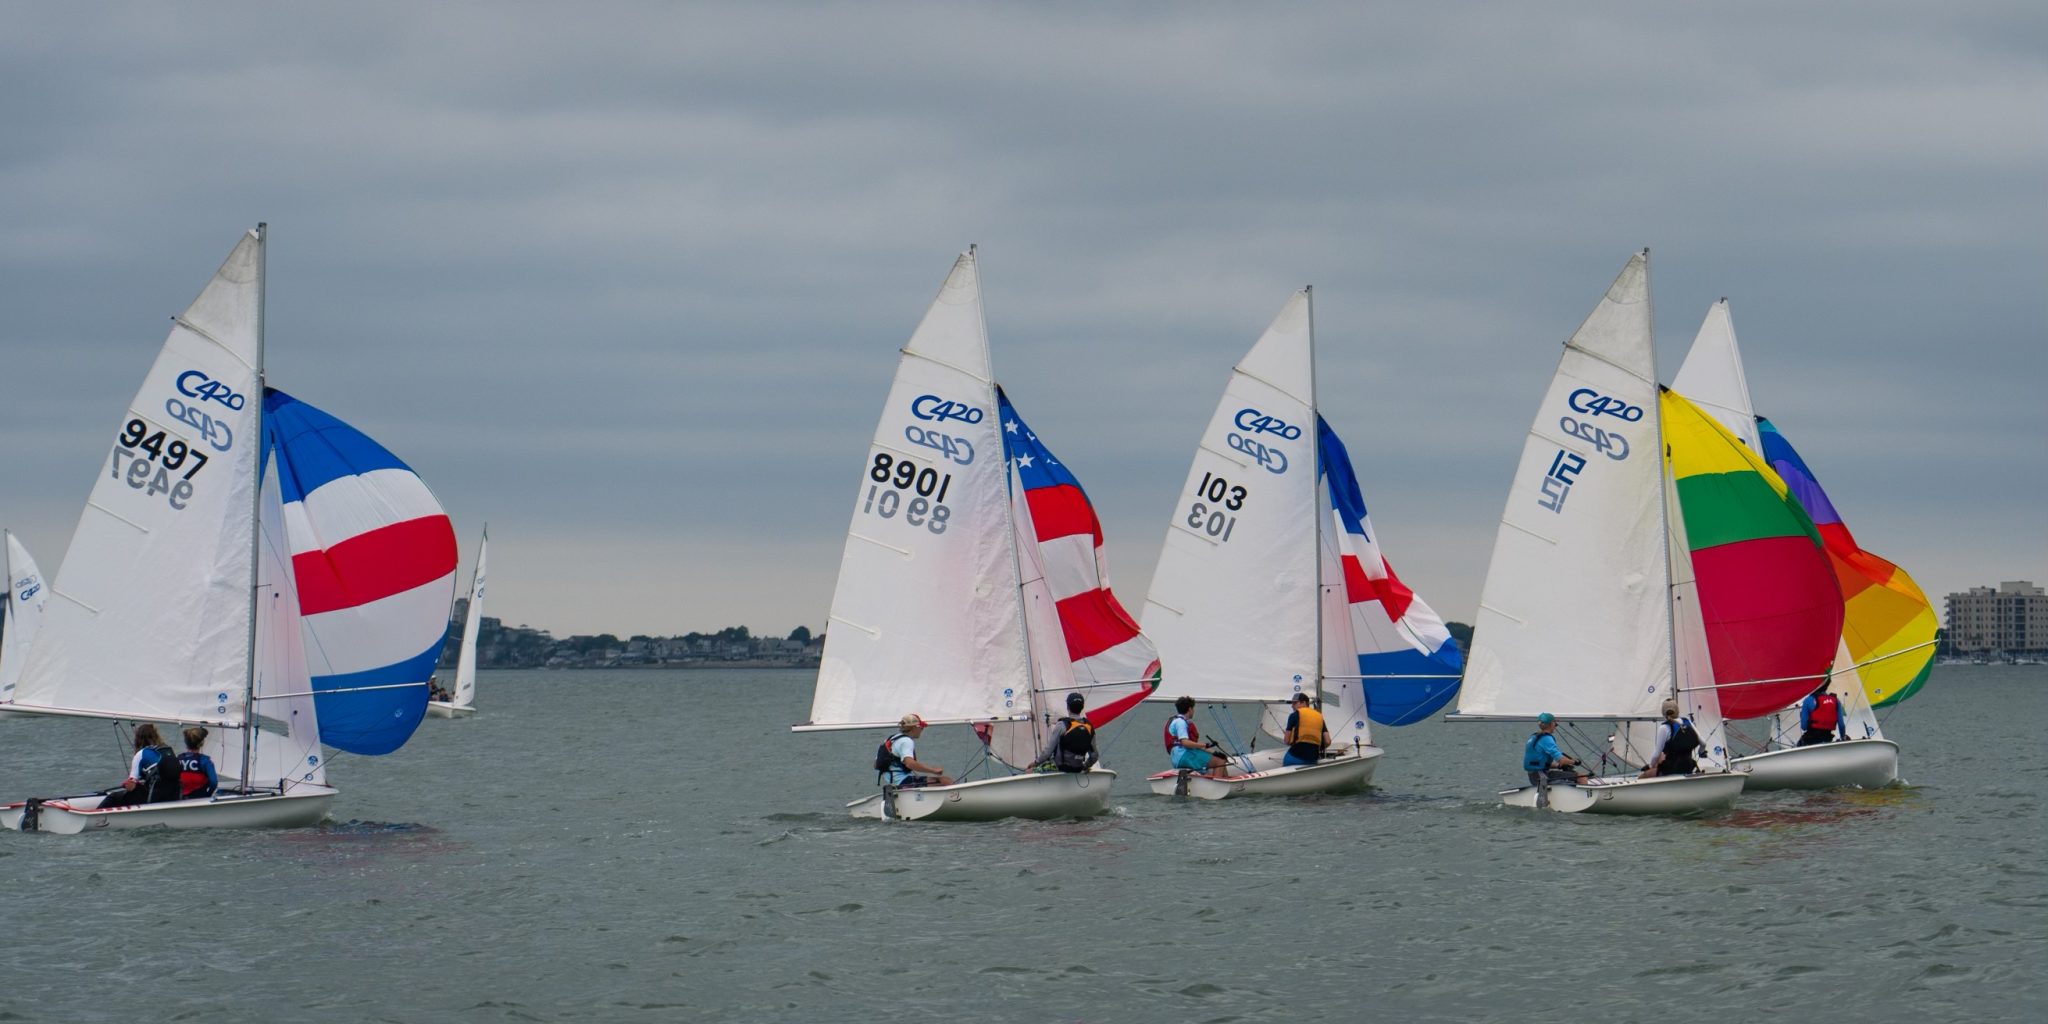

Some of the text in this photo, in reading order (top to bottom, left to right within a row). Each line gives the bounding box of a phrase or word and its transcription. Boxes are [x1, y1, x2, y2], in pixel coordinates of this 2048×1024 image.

[176, 370, 245, 411] C420
[1569, 388, 1643, 422] C420
[911, 395, 984, 424] C420
[1234, 408, 1302, 440] C420
[119, 418, 209, 481] 9497
[1547, 449, 1587, 486] 12
[870, 453, 951, 503] 8901
[1197, 471, 1247, 511] 103
[179, 759, 199, 770] YC
